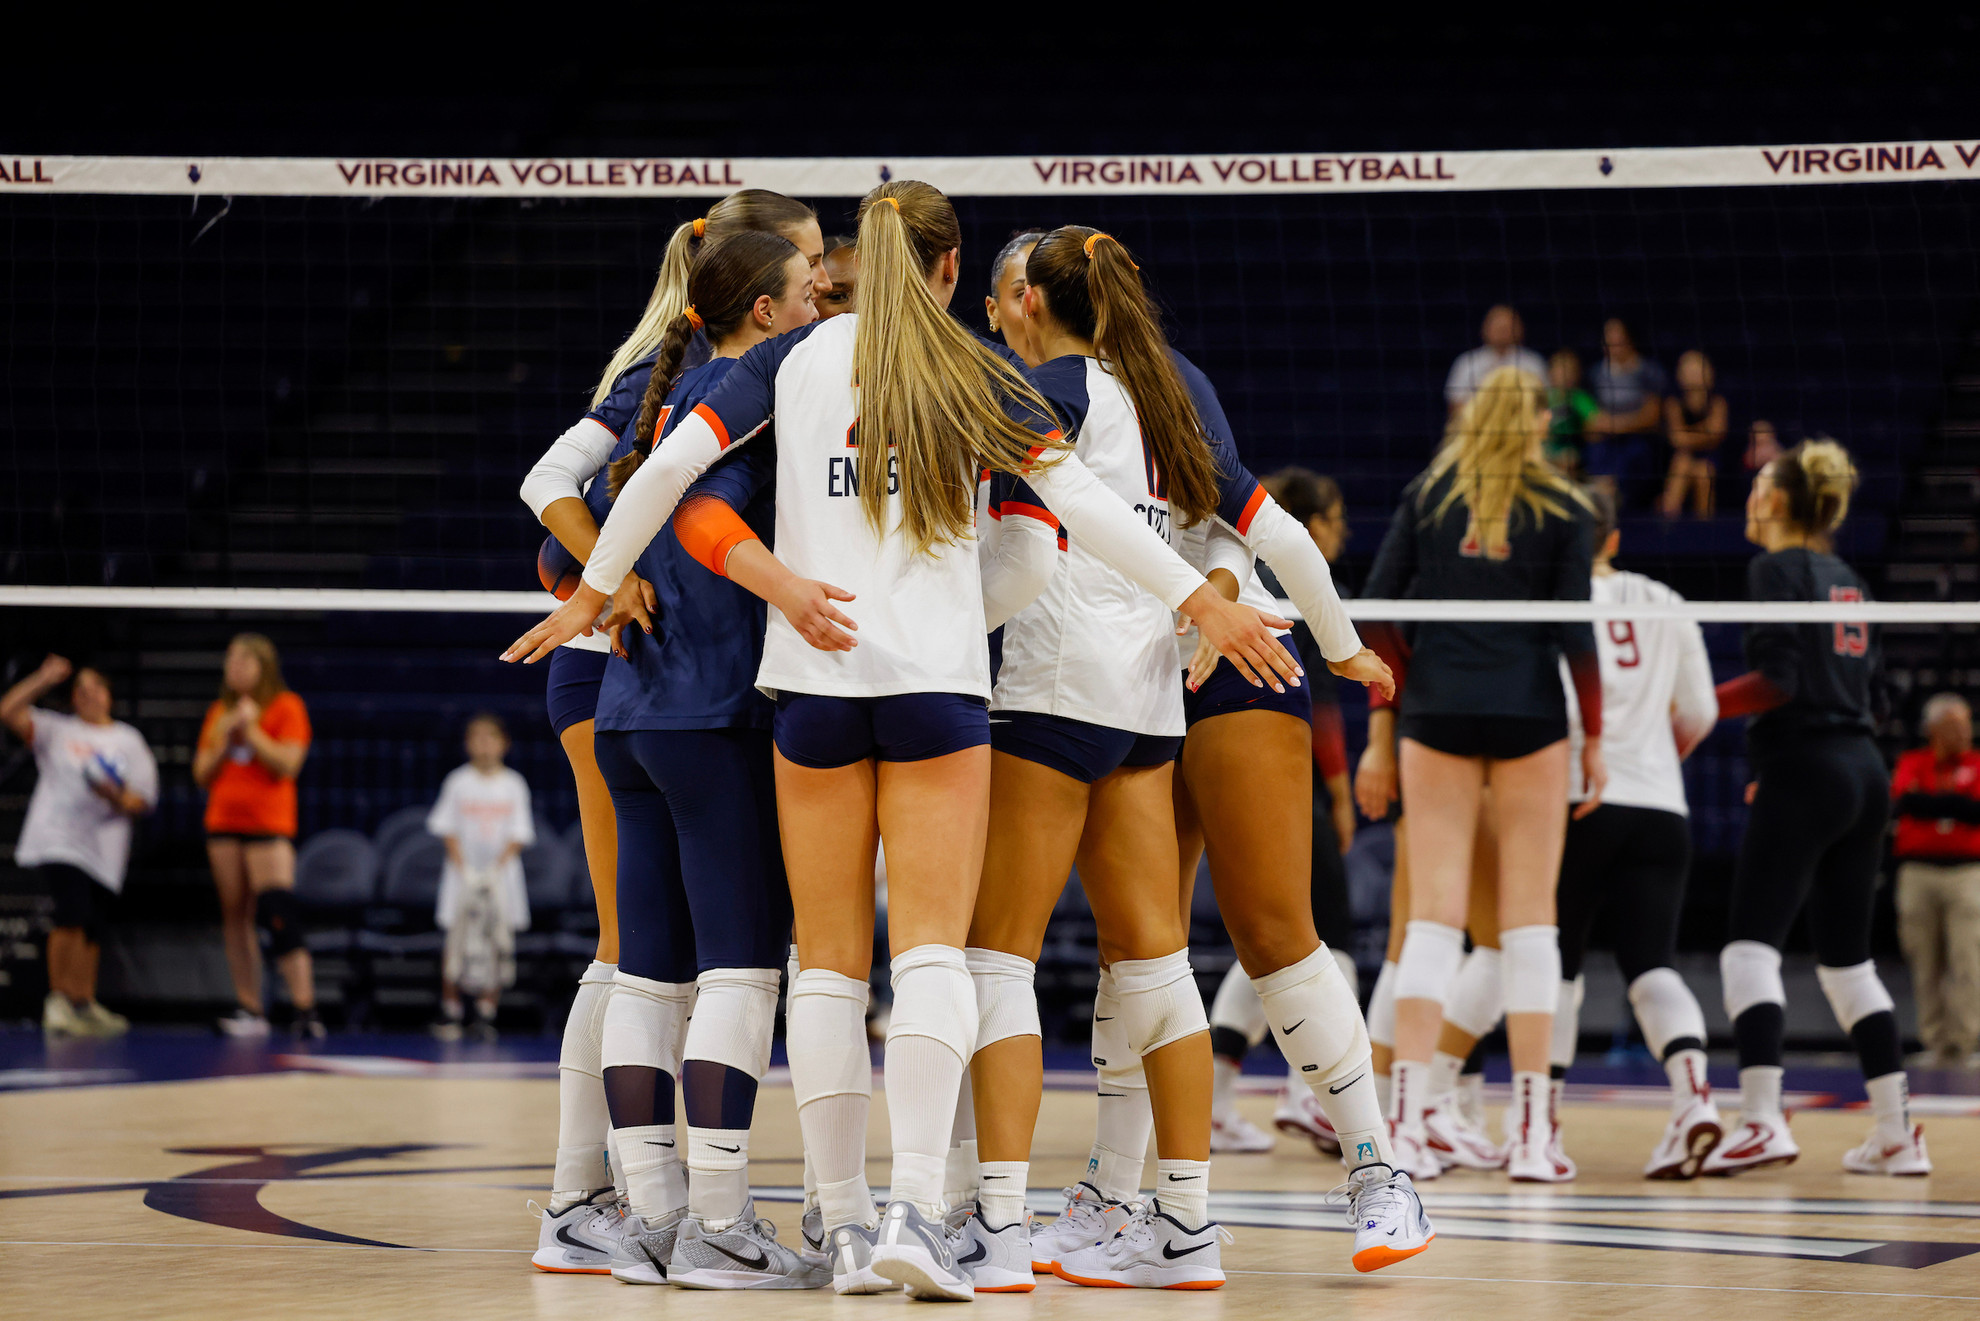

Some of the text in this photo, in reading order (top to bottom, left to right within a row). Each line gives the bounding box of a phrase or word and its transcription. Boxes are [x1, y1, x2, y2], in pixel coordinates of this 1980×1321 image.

[337, 162, 743, 186] VIRGINIA VOLLEYBALL
[1033, 158, 1455, 185] VIRGINIA VOLLEYBALL
[1762, 146, 1946, 174] VIRGINIA
[828, 456, 900, 497] ENS
[1607, 618, 1640, 668] 9
